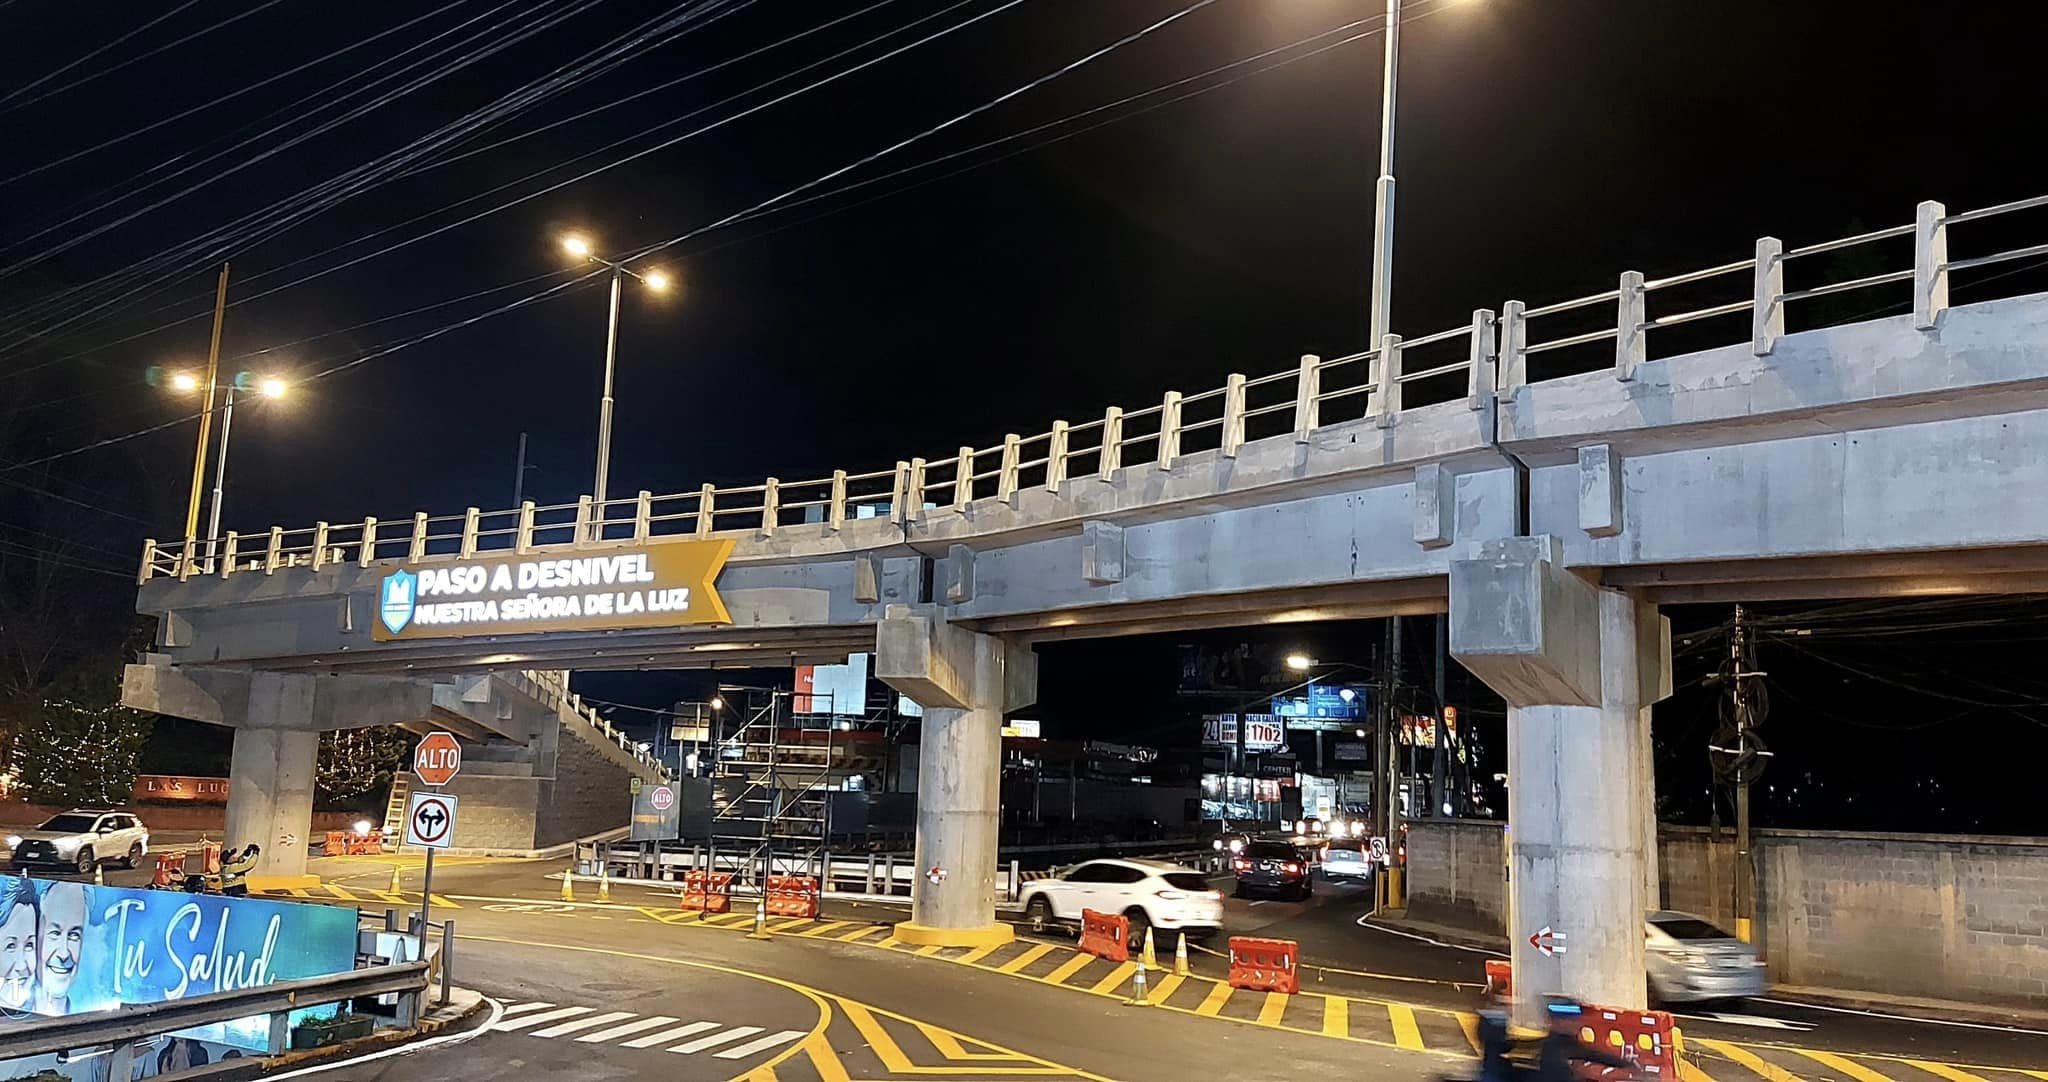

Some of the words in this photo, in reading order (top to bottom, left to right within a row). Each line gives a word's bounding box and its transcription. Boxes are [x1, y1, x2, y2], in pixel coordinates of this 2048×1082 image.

[416, 568, 487, 597] PASO
[490, 566, 513, 592] A
[517, 553, 655, 591] DESNIVEL
[413, 600, 499, 626] NUESTRA
[499, 592, 583, 621] SEÑORA
[583, 592, 614, 616] DE
[616, 590, 646, 613] LA
[647, 587, 690, 611] LUZ
[1203, 720, 1218, 740] 24
[1251, 723, 1281, 743] 1702
[417, 748, 458, 769] ALTO
[147, 781, 182, 793] LAS
[654, 793, 671, 804] ALTO
[104, 898, 154, 994] Tu
[163, 902, 282, 1000] Salud
